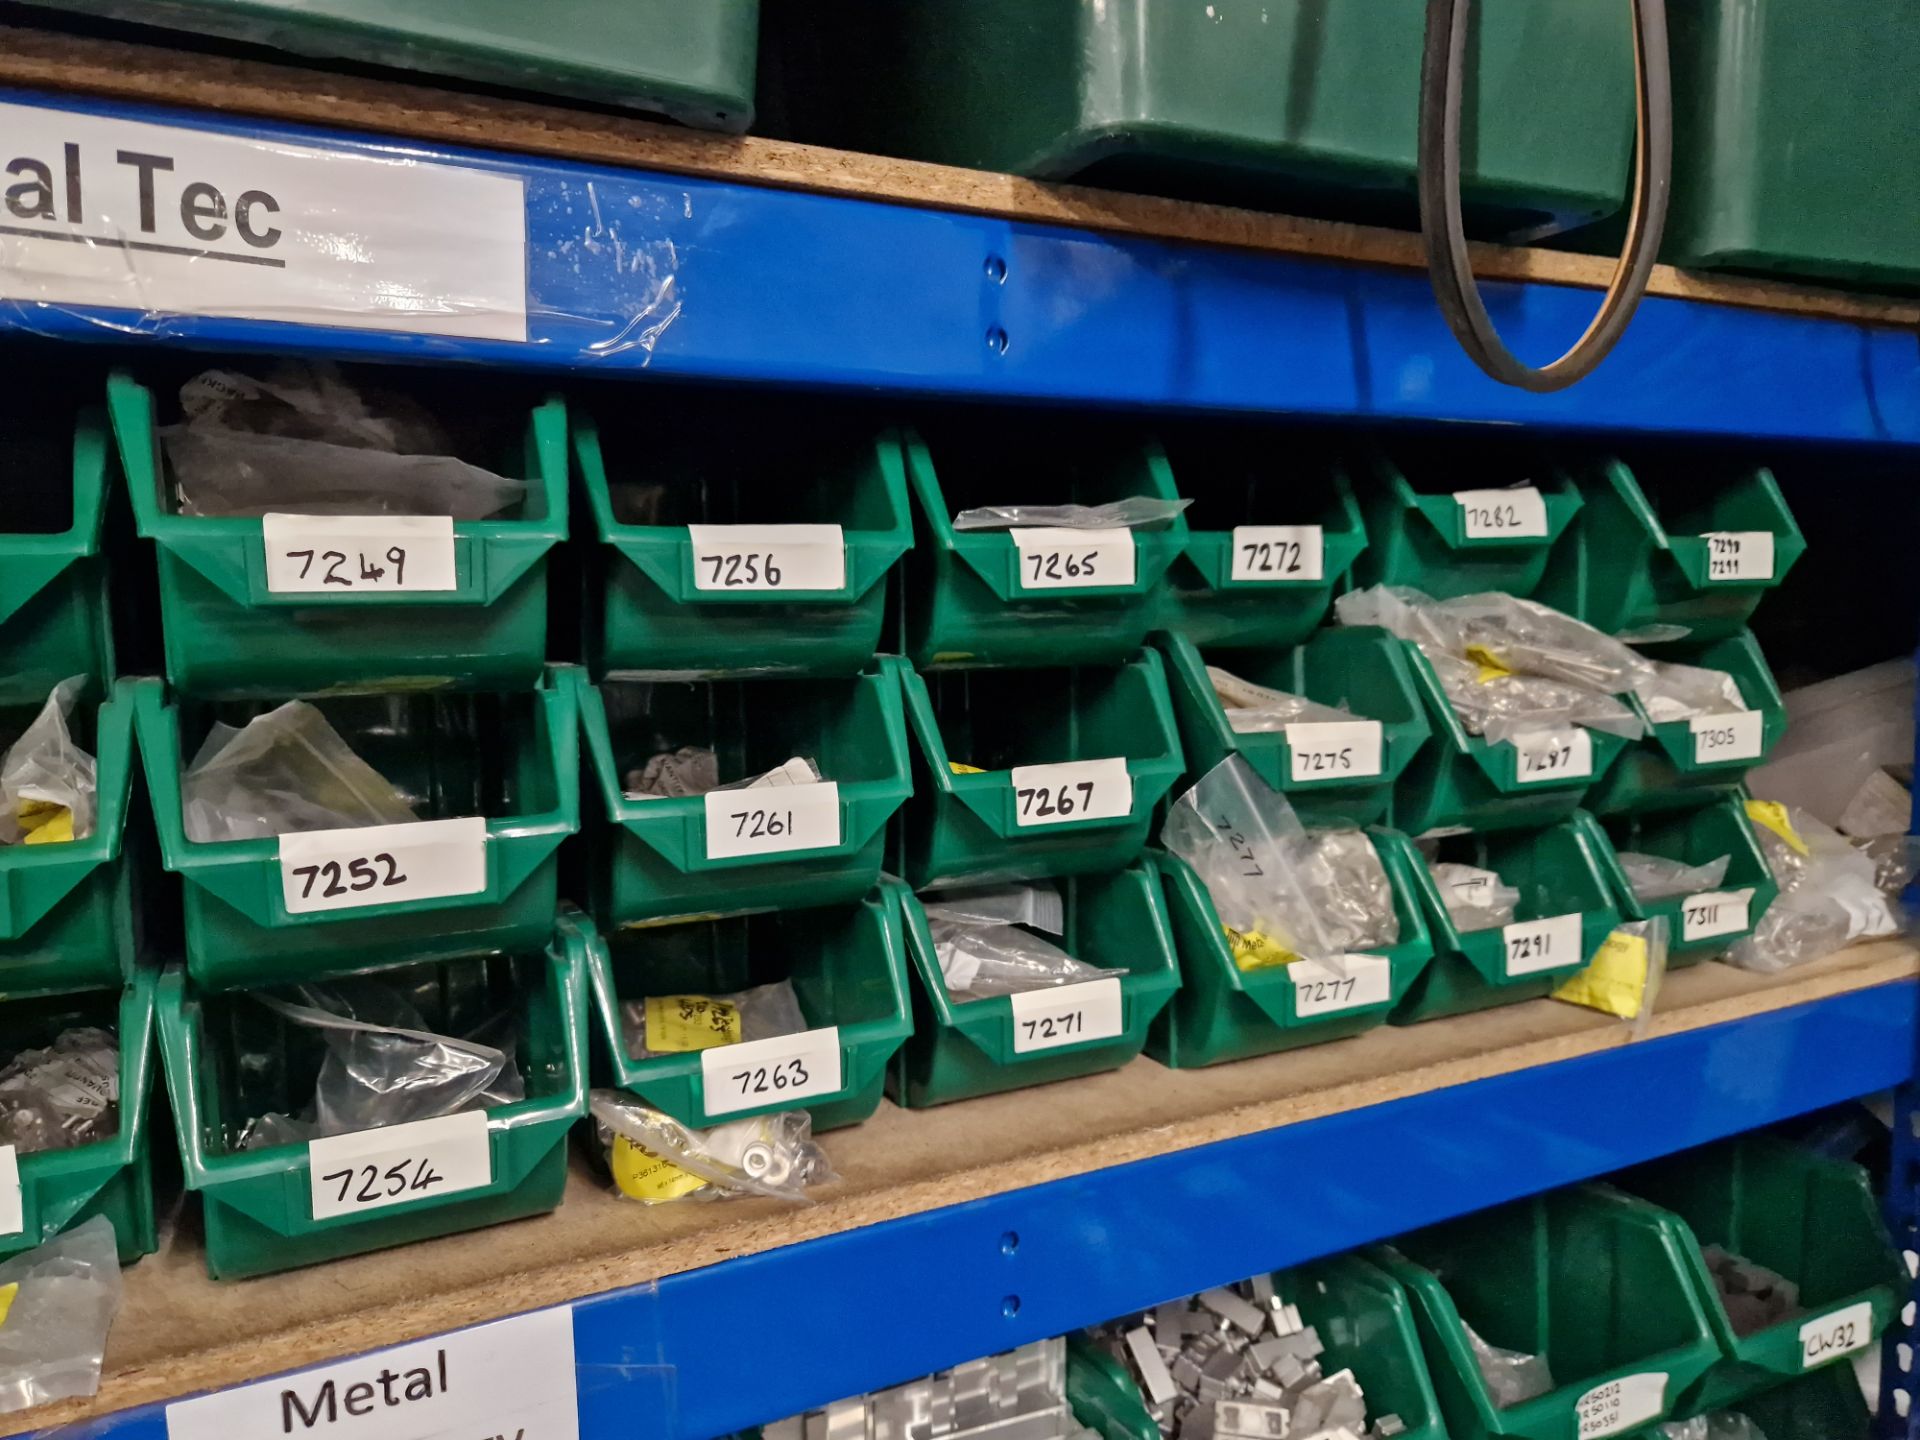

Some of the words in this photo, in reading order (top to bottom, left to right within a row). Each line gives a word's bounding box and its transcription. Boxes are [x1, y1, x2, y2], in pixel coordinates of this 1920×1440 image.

[116, 150, 283, 248] Tec
[286, 546, 406, 586] 7249
[700, 553, 782, 586] 7256
[1027, 551, 1098, 580] 7265
[1243, 542, 1301, 573] 7272
[1700, 727, 1736, 749] 7305
[1297, 748, 1352, 771] 7275
[1017, 781, 1095, 817] 7267
[730, 809, 793, 838] 7261
[292, 853, 407, 899] 7252
[1686, 904, 1719, 926] 7311
[1510, 933, 1551, 961] 7291
[1298, 977, 1357, 1003] 7277
[1022, 1013, 1083, 1041] 7271
[732, 1059, 809, 1096] 7263
[322, 1157, 443, 1203] 7254
[1805, 1322, 1856, 1359] CW32
[279, 1349, 449, 1434] Metal
